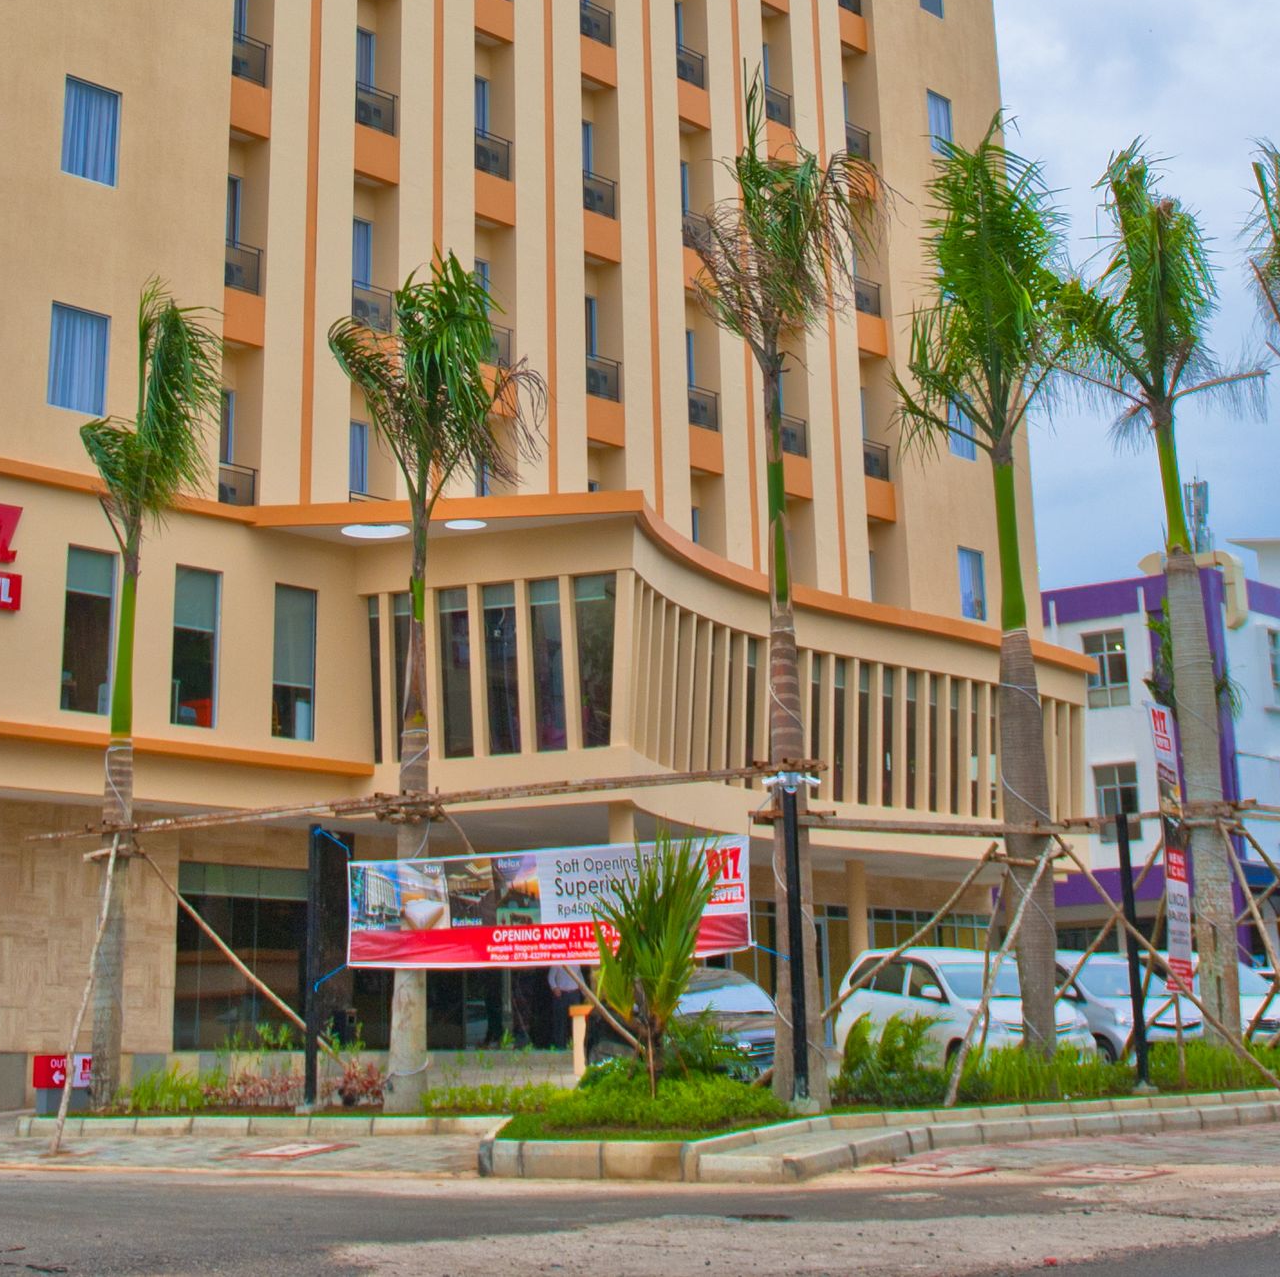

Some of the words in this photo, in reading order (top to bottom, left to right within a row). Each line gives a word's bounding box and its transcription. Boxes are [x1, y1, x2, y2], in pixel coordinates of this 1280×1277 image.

[423, 864, 441, 874] Stay
[555, 858, 579, 874] Soft
[583, 855, 639, 874] Opening
[705, 847, 742, 880] BIZ
[554, 874, 626, 900] Superior
[493, 928, 540, 942] OPENING
[543, 927, 570, 940] NOW
[50, 1058, 67, 1069] OUT
